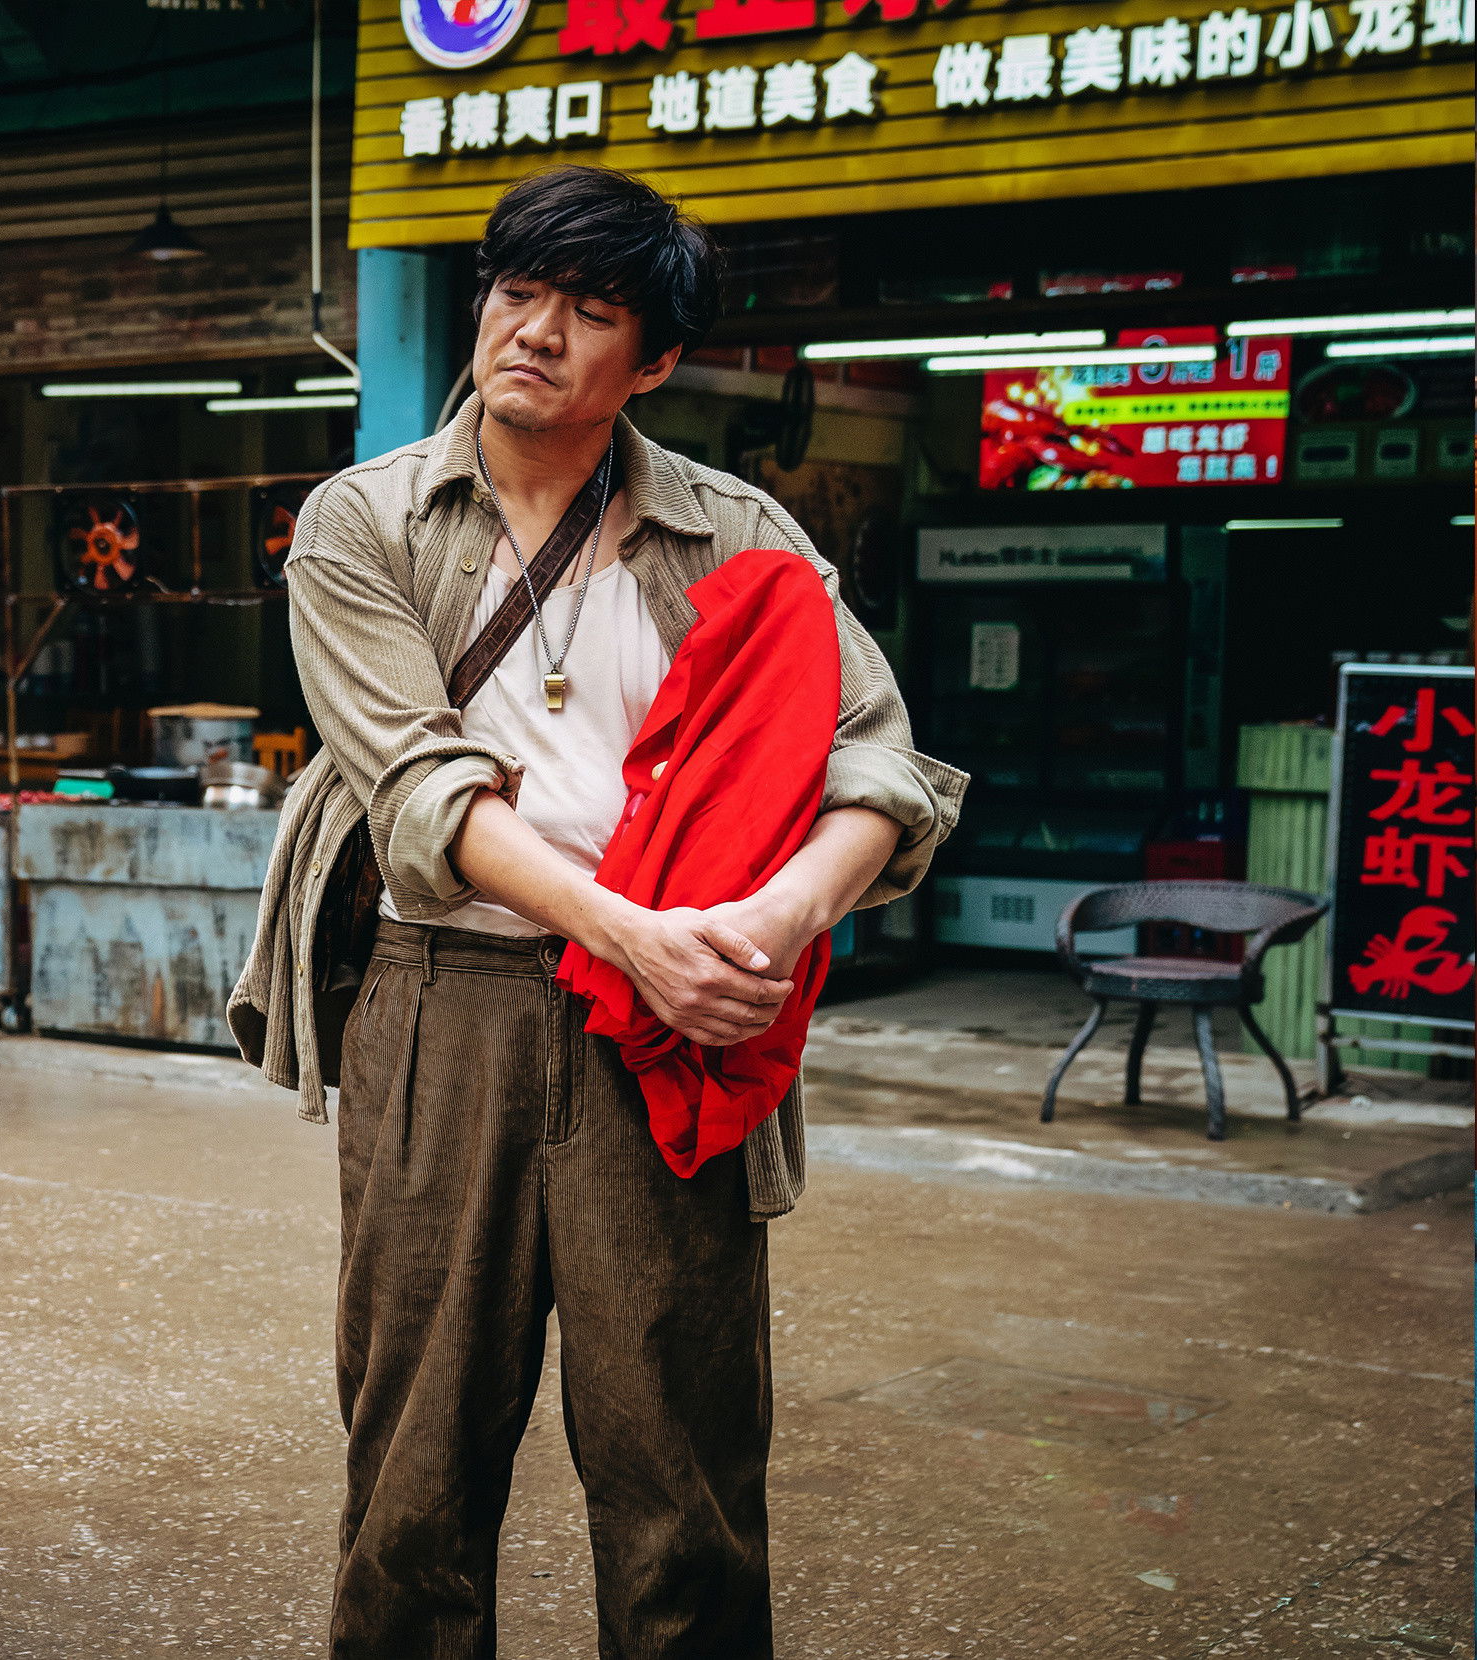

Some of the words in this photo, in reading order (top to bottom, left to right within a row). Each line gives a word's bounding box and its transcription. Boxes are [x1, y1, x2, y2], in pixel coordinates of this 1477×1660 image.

[400, 80, 603, 157] 香辣爽口
[648, 52, 878, 132] 地道美食
[1359, 688, 1477, 898] 小龙虾
